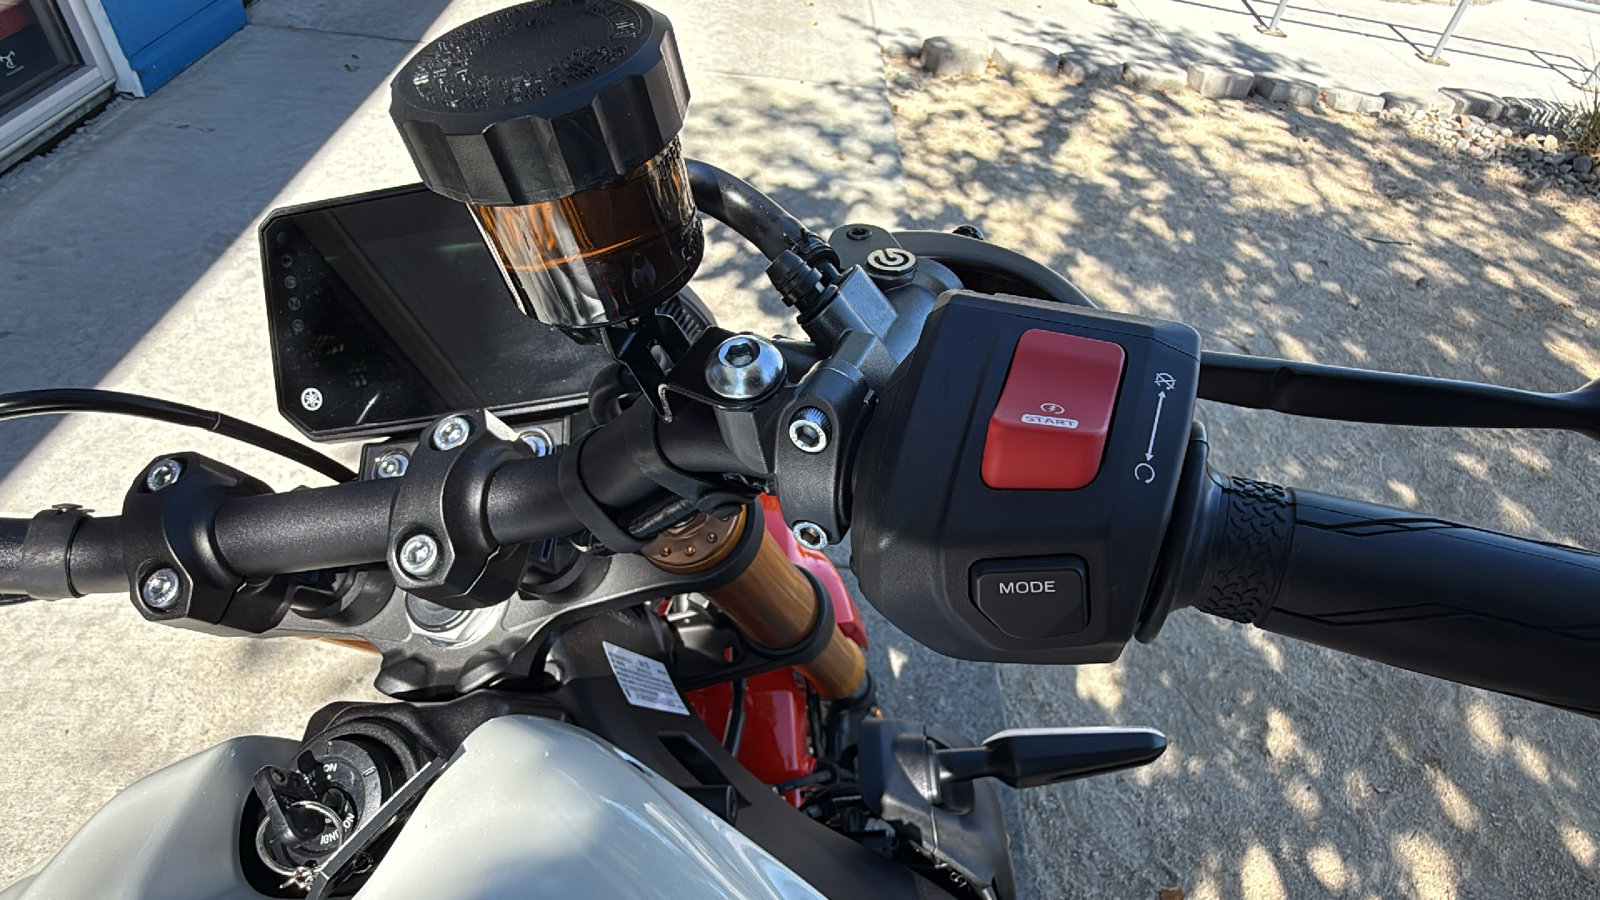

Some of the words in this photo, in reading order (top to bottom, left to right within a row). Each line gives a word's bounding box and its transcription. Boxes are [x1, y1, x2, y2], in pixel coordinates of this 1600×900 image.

[1024, 415, 1077, 427] START
[999, 580, 1056, 594] MODE
[323, 763, 337, 773] ON
